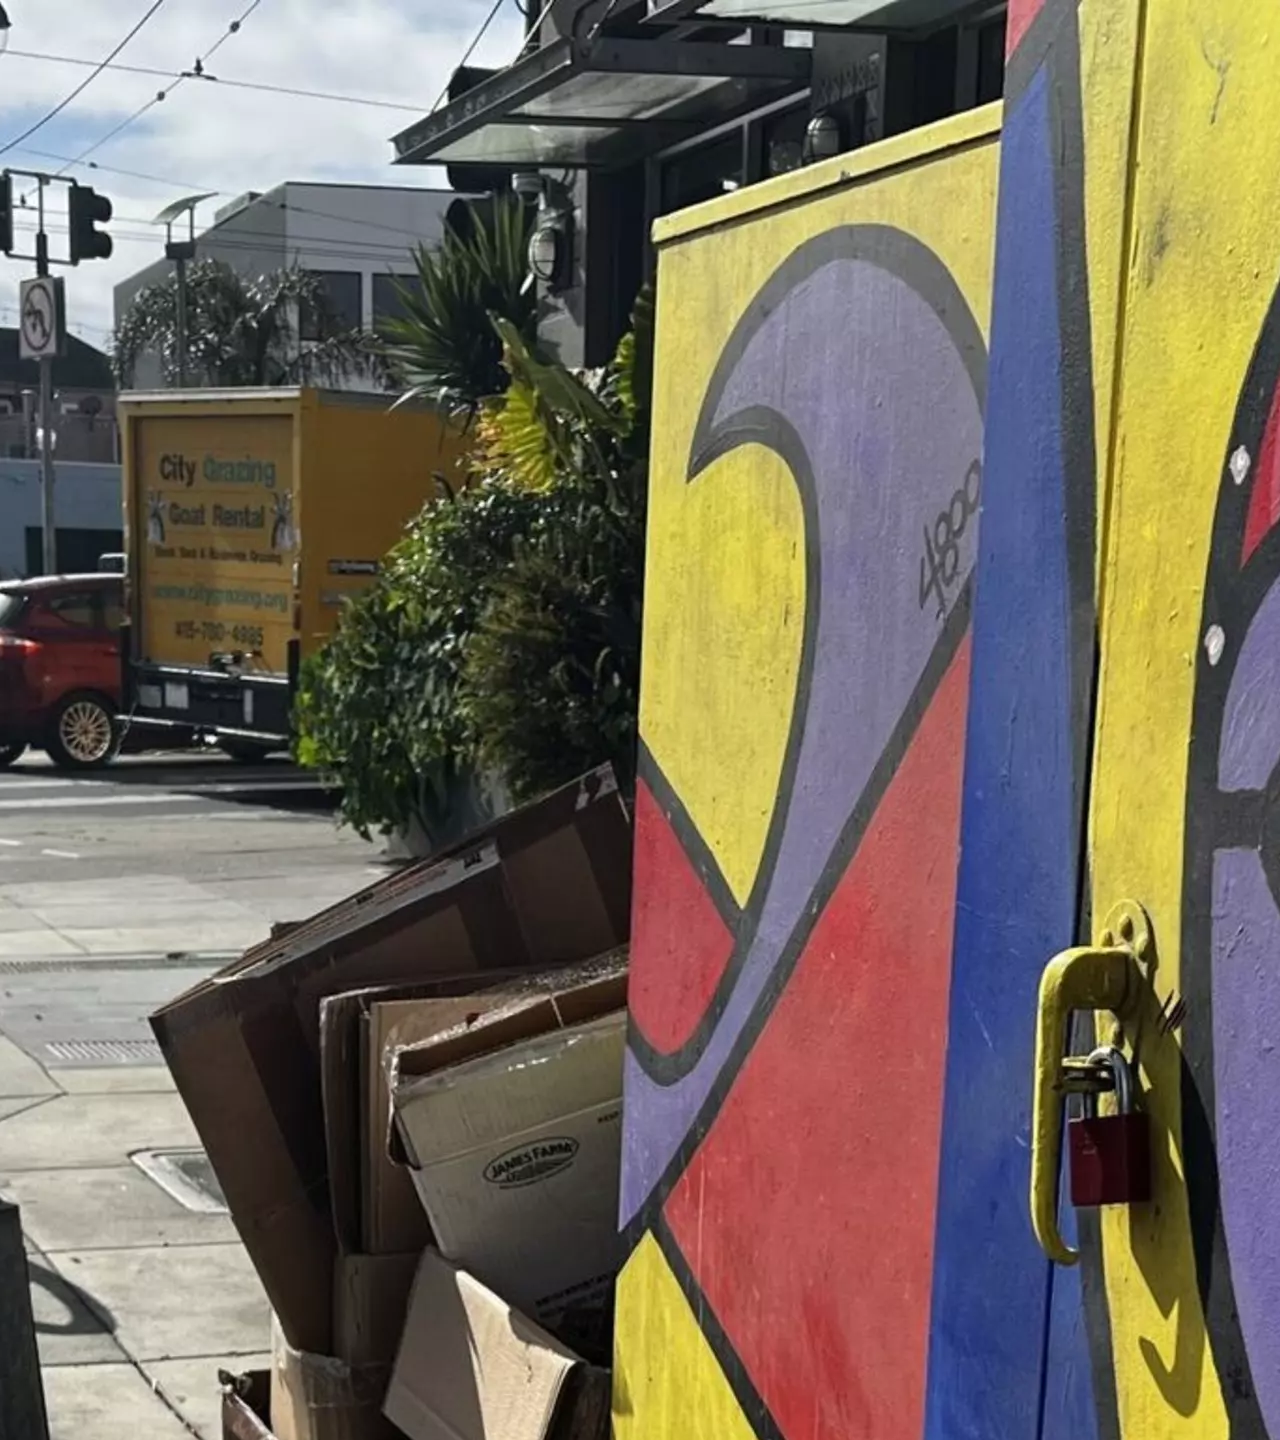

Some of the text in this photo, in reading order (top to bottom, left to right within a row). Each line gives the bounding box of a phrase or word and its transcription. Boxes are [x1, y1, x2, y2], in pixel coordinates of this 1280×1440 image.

[159, 453, 276, 488] City Grazing
[169, 502, 265, 529] Goat Rental
[491, 1151, 533, 1179] JAMES
